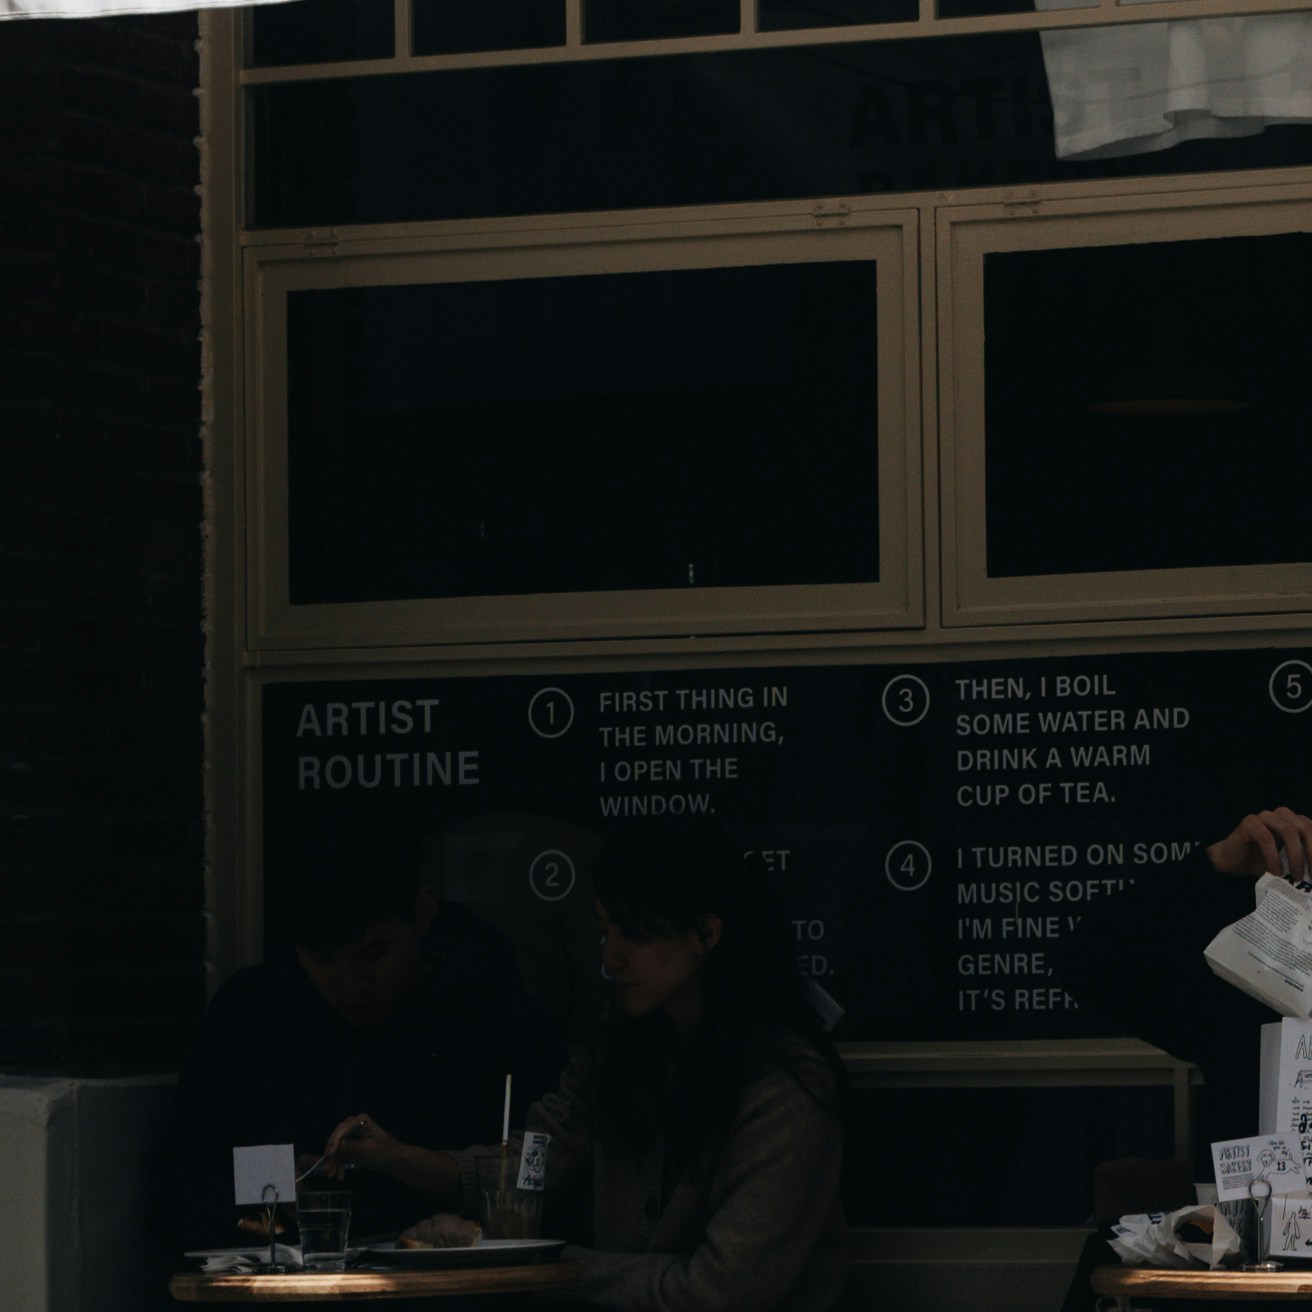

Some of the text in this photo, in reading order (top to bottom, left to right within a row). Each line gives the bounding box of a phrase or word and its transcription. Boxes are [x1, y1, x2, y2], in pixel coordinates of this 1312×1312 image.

[599, 686, 788, 713] FIRST THING IN
[954, 674, 1117, 701] THEN, I BOIL
[296, 698, 440, 737] ARTIST
[956, 707, 1190, 736] SOME WATER AND
[598, 721, 784, 748] THE MORNING,
[298, 750, 480, 790] ROUTINE
[600, 757, 739, 783] I OPEN THE
[957, 744, 1150, 772] DRINK A WARM
[599, 793, 715, 817] WINDOW.
[957, 781, 1116, 807] CUP OF TEA.
[957, 847, 963, 869] I
[971, 844, 1078, 868] TURNED
[1086, 843, 1124, 866] ON
[957, 881, 1040, 905] MUSIC
[958, 917, 992, 940] I'M
[1002, 915, 1060, 939] FINE
[957, 952, 1053, 977] GENRE,
[958, 988, 1006, 1011] IT'S
